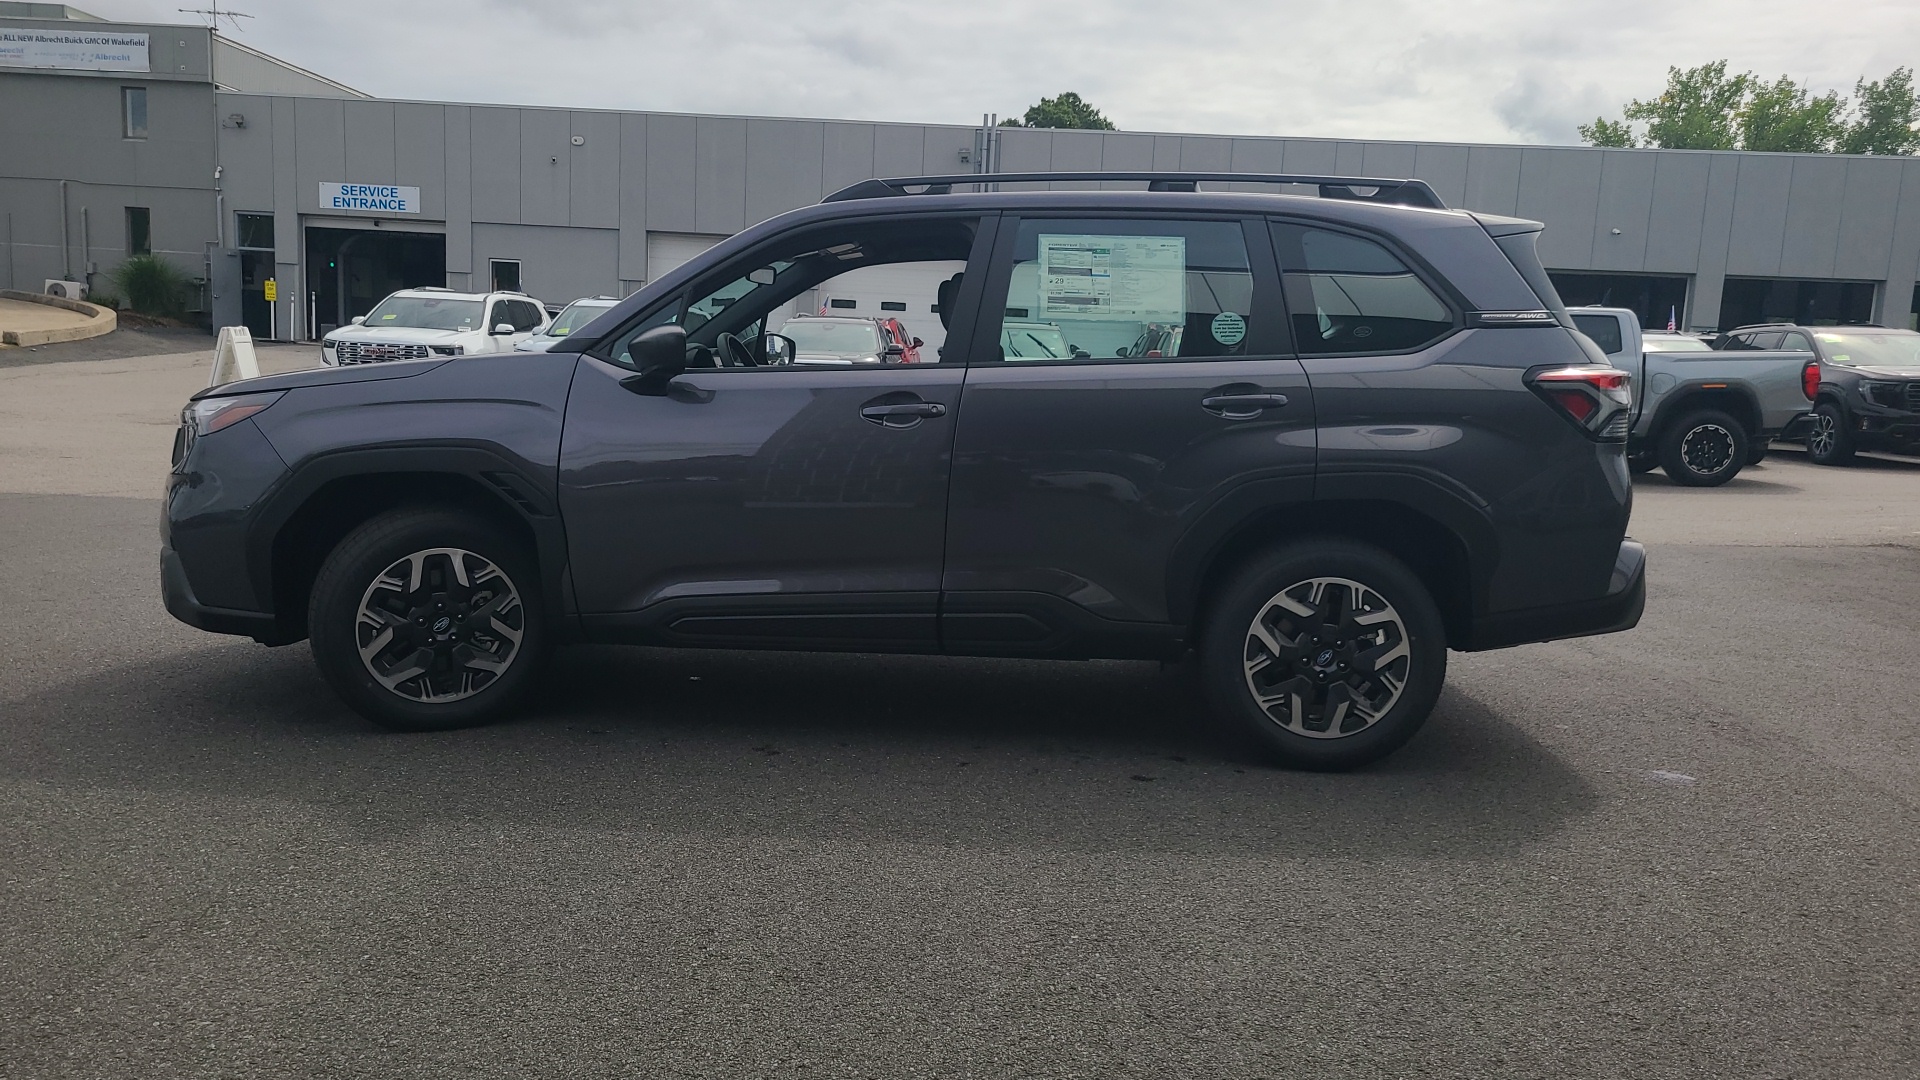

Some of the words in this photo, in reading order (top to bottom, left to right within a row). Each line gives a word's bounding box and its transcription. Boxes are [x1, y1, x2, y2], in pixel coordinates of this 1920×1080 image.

[4, 34, 16, 42] ALL
[17, 34, 33, 42] NEW
[35, 35, 64, 43] Albrecht
[64, 36, 83, 44] Buick
[84, 37, 101, 45] GMC
[101, 37, 110, 46] Of
[111, 38, 145, 47] Wakefield
[95, 53, 131, 62] Albrecht
[341, 185, 399, 198] SERVICE
[333, 196, 406, 211] ENTRANCE
[1054, 277, 1064, 285] 29
